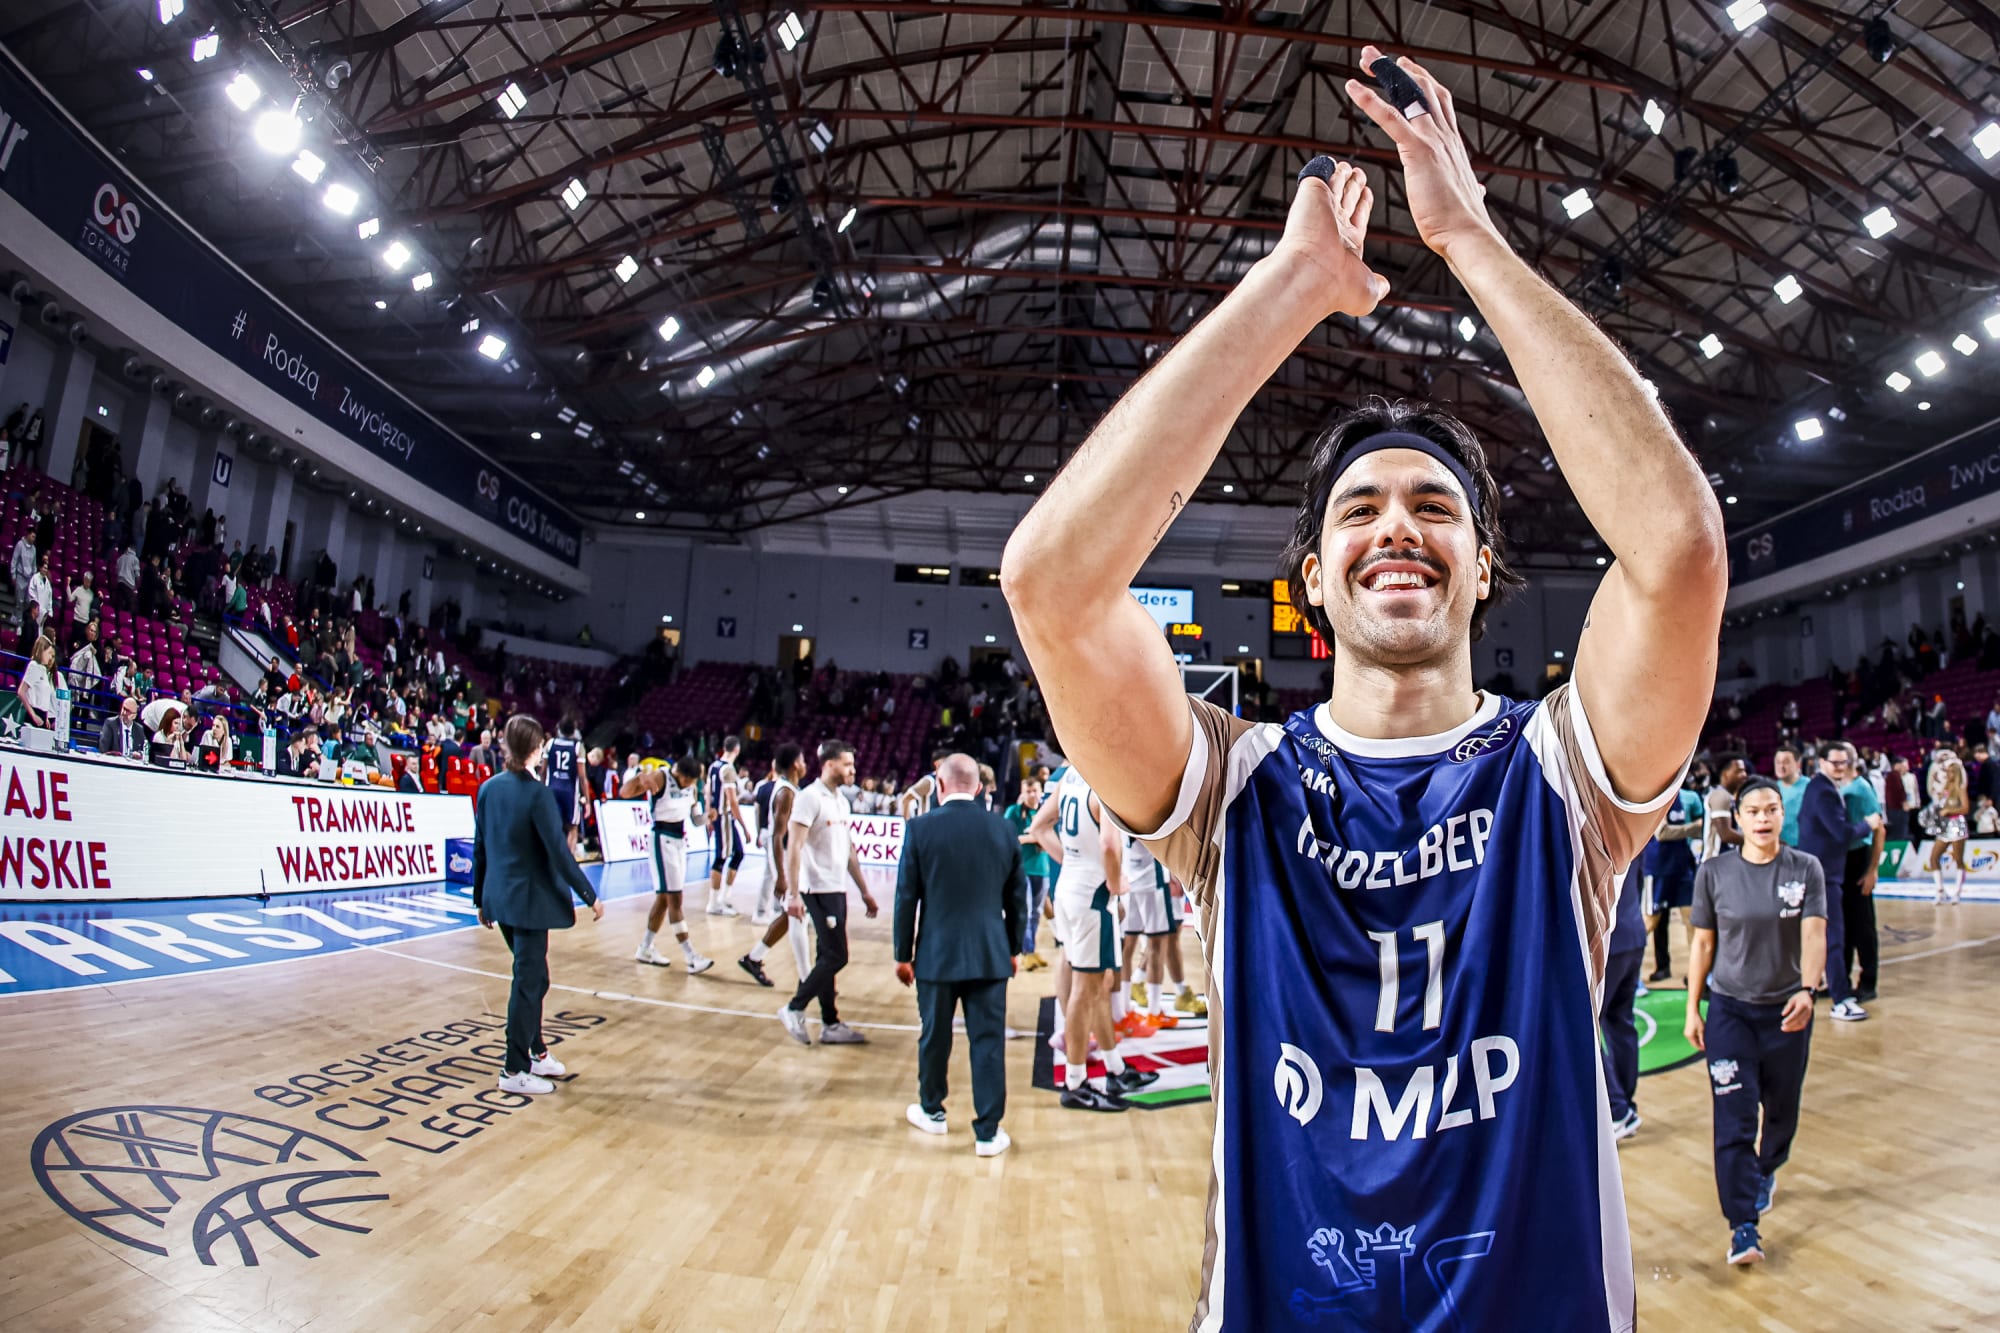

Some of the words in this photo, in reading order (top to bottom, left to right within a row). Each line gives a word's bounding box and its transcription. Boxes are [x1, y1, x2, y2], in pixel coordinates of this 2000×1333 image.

[81, 226, 129, 272] TORWAR
[263, 333, 320, 400] Rodzą
[339, 386, 415, 461] Zwycięzcy
[216, 462, 229, 484] U
[1948, 446, 2000, 490] Zwyc
[1138, 591, 1178, 606] ders
[555, 750, 570, 770] 12
[0, 764, 72, 821] AJE
[291, 796, 415, 833] TRAMWAJE
[276, 844, 437, 884] WARSZAWSKIE
[0, 887, 478, 984] ARSZAW
[1367, 920, 1446, 1033] 11
[1350, 1035, 1520, 1141] MLP
